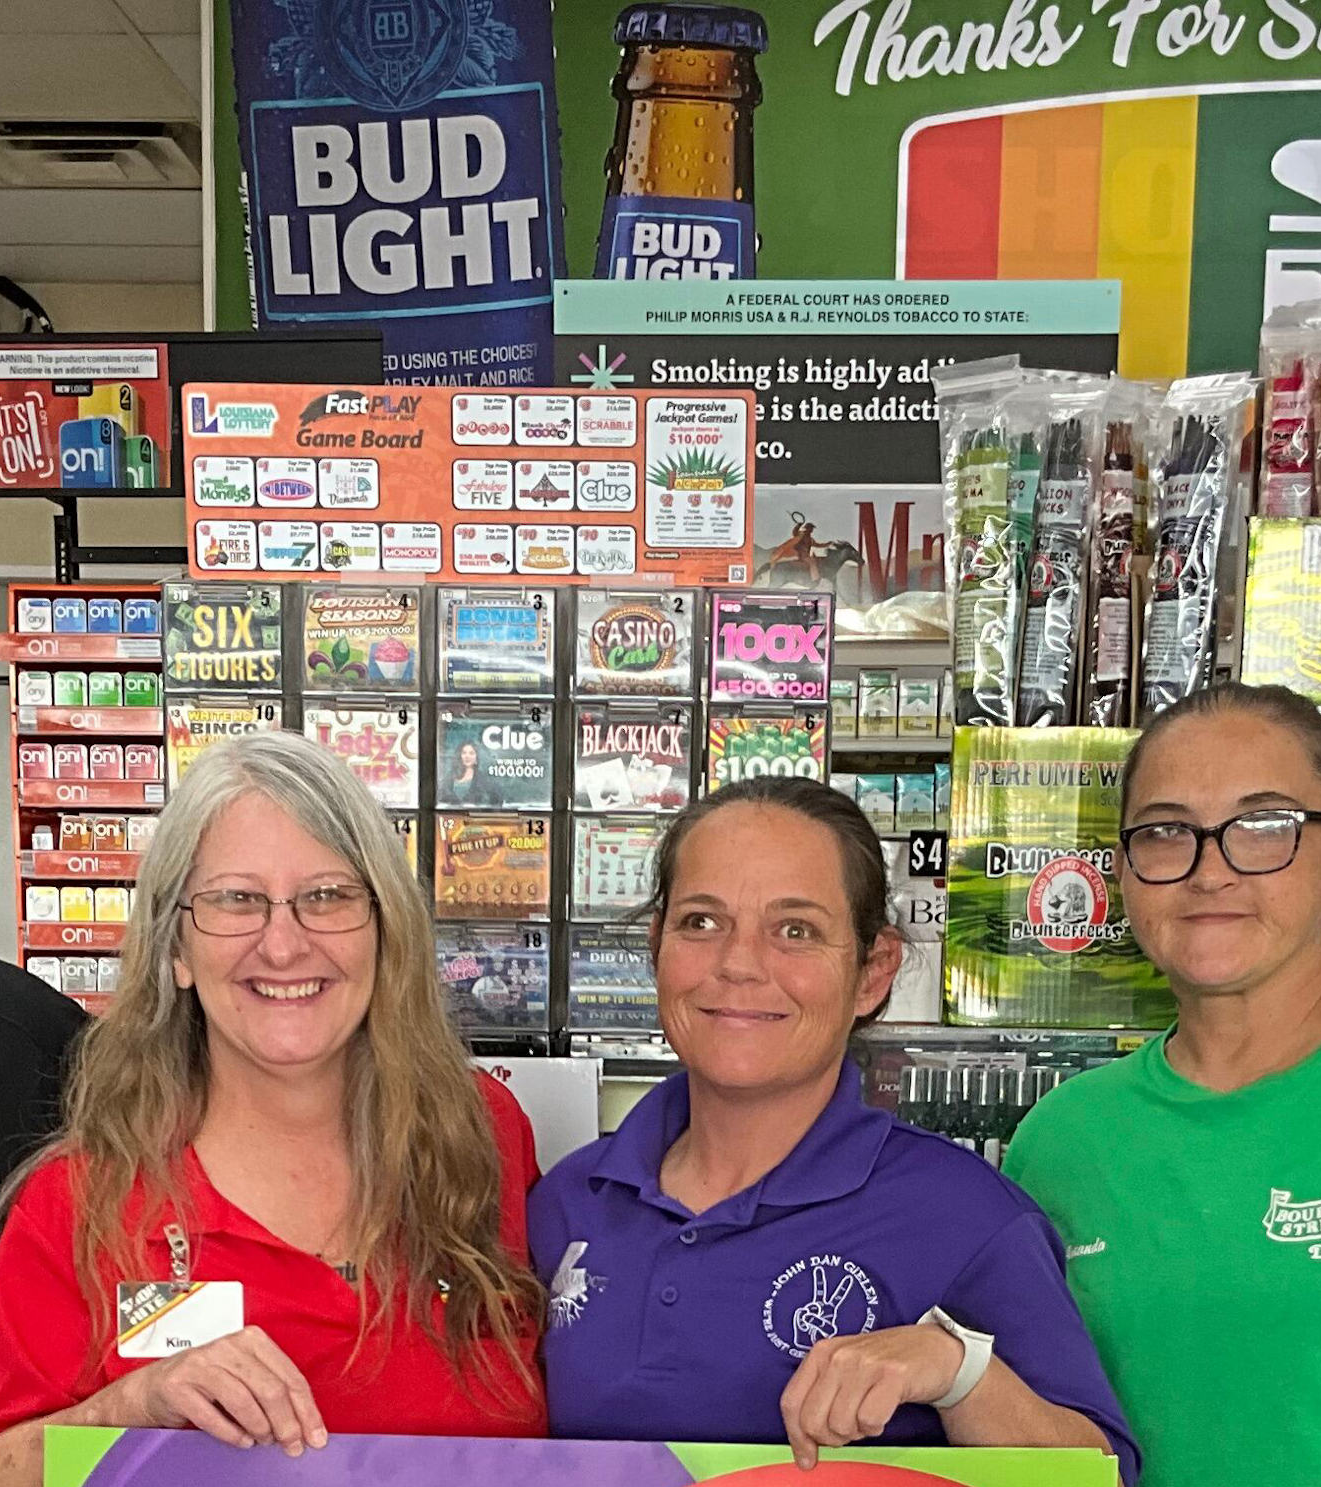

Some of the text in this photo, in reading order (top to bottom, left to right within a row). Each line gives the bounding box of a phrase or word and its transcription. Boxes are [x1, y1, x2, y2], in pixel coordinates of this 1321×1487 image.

[813, 0, 1084, 96] Thanks
[1107, 0, 1246, 68] For
[291, 114, 507, 207] BUD
[268, 198, 540, 296] LIGHT
[632, 222, 722, 259] BUD
[726, 294, 949, 305] A FEDERAL COURT HAS ORDERED
[646, 312, 1029, 322] PHILIP MORRIS USA & R.J. REYNOLDS TOBACCO TO STATE:
[651, 358, 892, 391] Smoking is highly
[220, 407, 275, 418] LOUISIANA
[325, 395, 421, 414] Fast PLAY
[665, 401, 726, 413] Progressive
[769, 399, 843, 421] is the
[224, 419, 272, 429] LOTTERY
[582, 420, 633, 430] SCRABBLE
[655, 413, 738, 424] Jackpot Games!
[296, 430, 423, 448] Game Board
[62, 448, 104, 471] on!
[471, 493, 502, 504] FIVE
[581, 479, 631, 501] Clue
[192, 604, 256, 649] SIX
[593, 620, 674, 647] CASINO
[717, 622, 825, 664] 100X
[175, 652, 277, 682] FIGURES
[482, 726, 544, 751] Clue
[581, 723, 684, 759] BLACKJACK
[973, 761, 1091, 787] PERFUME
[523, 933, 542, 948] 18
[772, 1260, 806, 1290] JOHN
[810, 1255, 841, 1267] DAN
[166, 1337, 191, 1348] Kim
